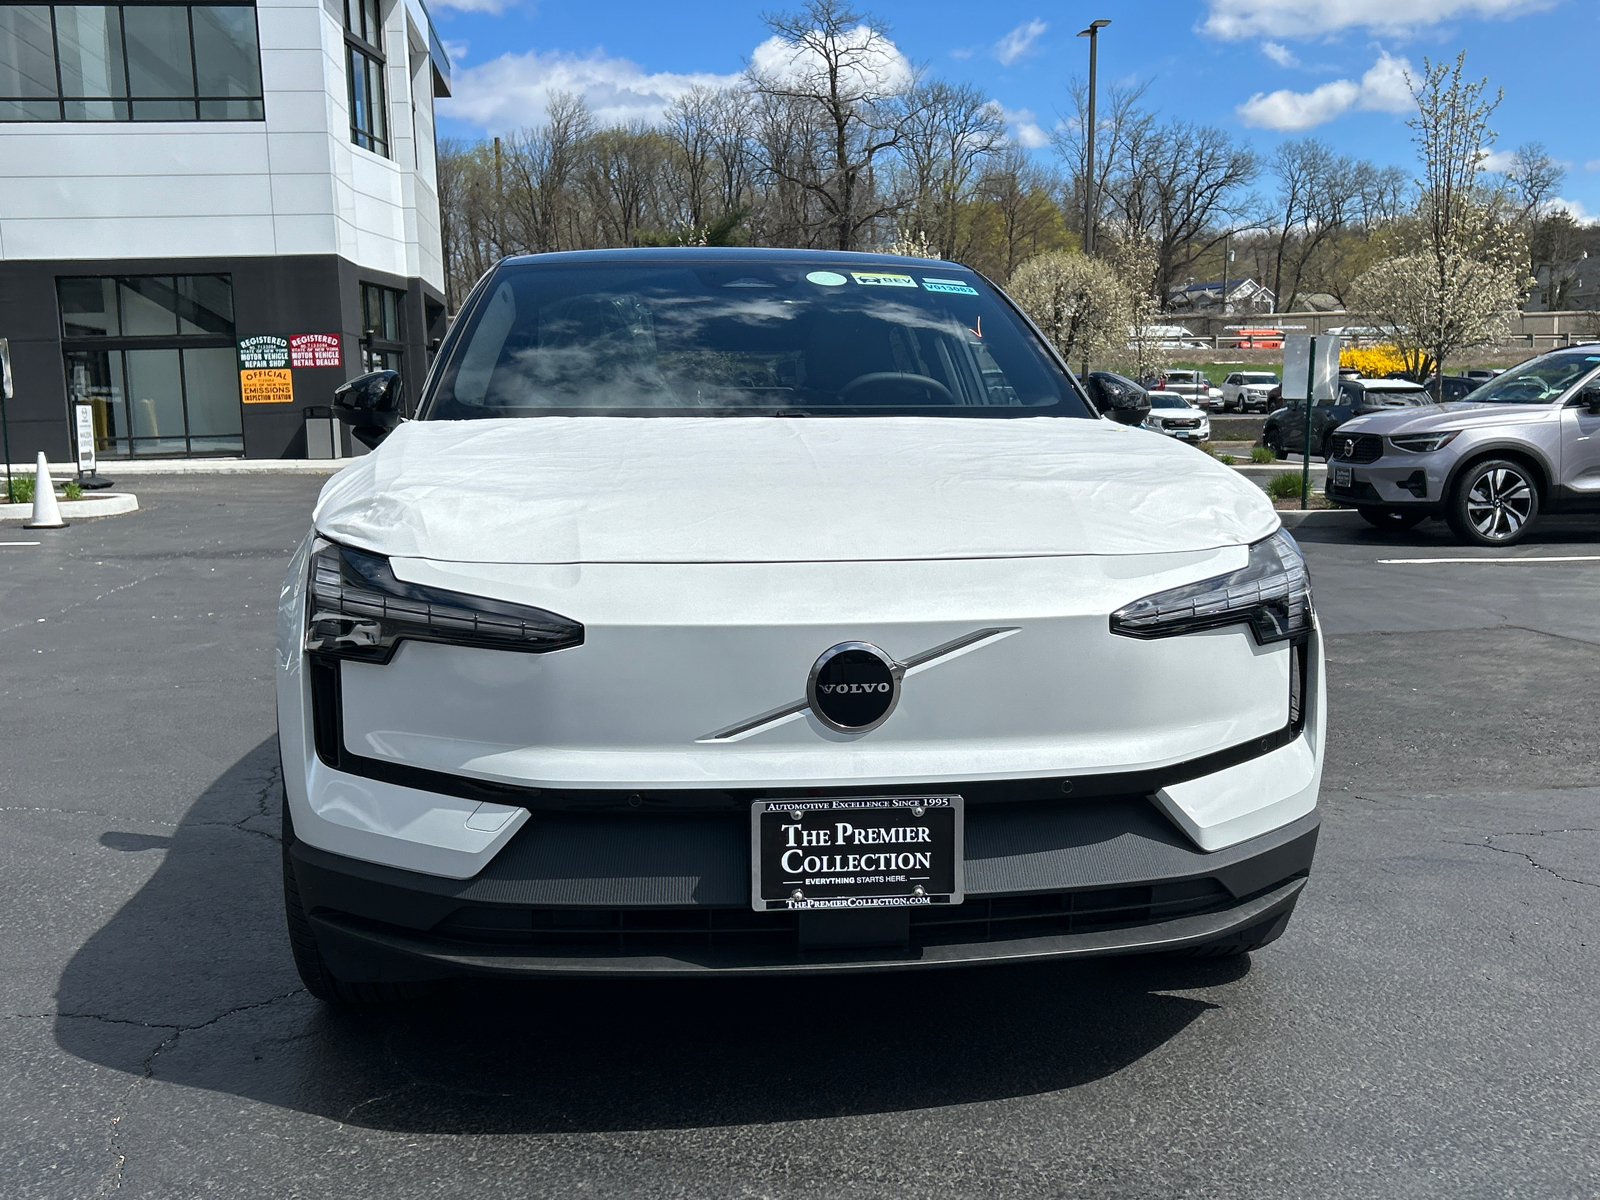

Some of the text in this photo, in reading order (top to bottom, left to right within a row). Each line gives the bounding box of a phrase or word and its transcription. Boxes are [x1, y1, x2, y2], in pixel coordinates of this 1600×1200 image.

[240, 336, 287, 349] REGISTERED
[291, 334, 338, 347] REGISTERED
[240, 352, 288, 361] MOTOR VEHICLE
[314, 351, 339, 359] VEHICLE
[245, 360, 267, 368] REPAIR
[315, 358, 339, 366] DEALER
[246, 370, 287, 380] OFFICIAL
[244, 386, 290, 394] EMISSIONS
[819, 682, 890, 694] VOLVO
[923, 798, 948, 806] 1995
[805, 877, 855, 885] EVERYTHING
